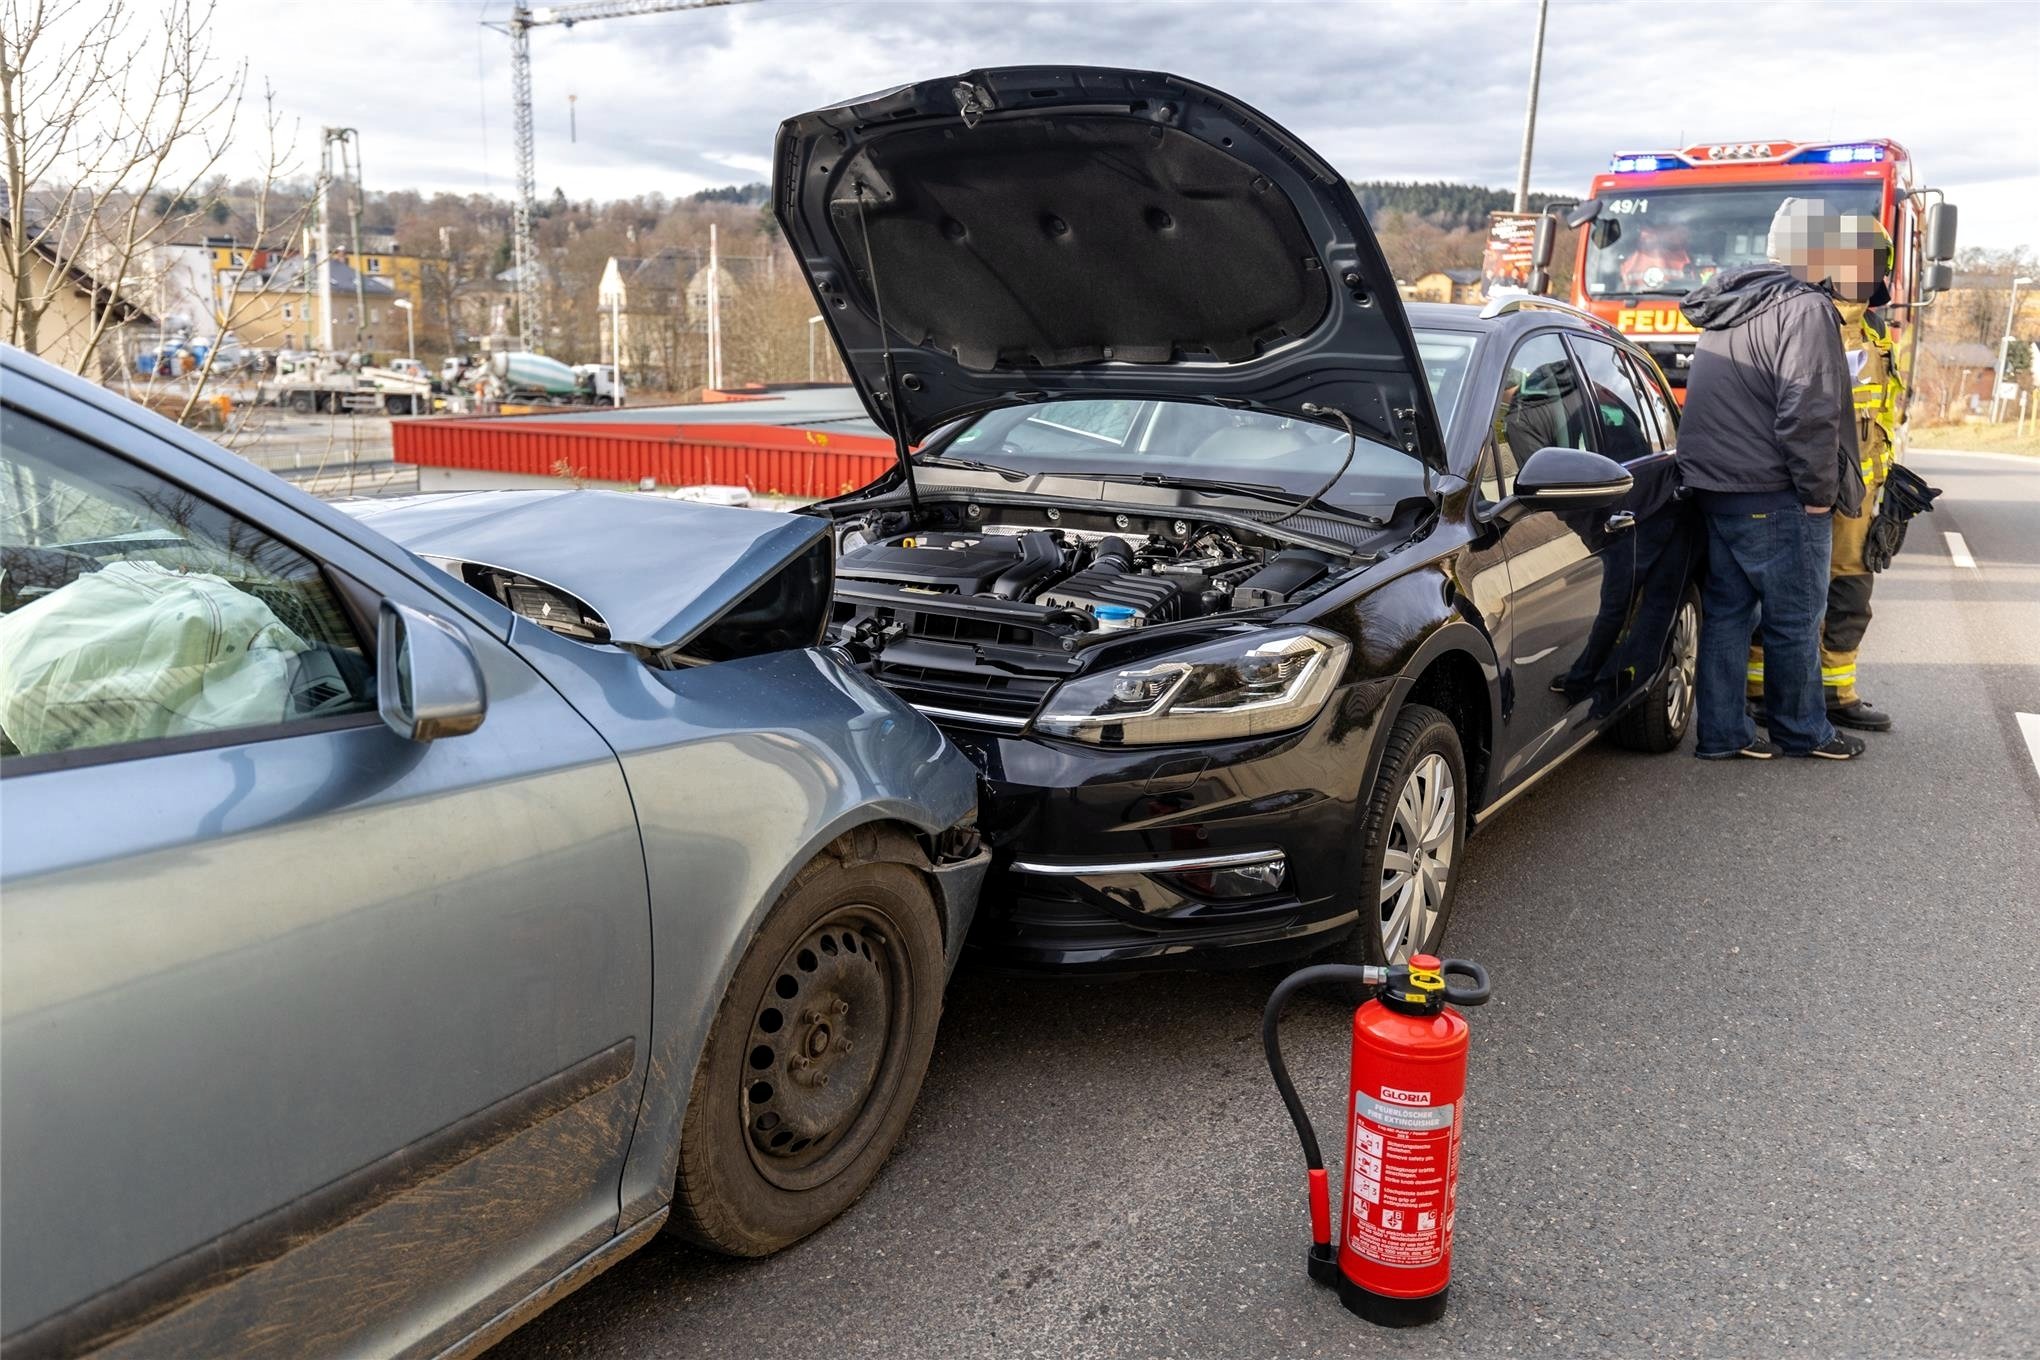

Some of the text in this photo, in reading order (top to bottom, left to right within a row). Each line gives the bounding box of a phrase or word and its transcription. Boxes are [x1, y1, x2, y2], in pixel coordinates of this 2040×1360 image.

[1608, 198, 1648, 215] 49/1
[1382, 1089, 1428, 1102] GLORIA
[1368, 1109, 1440, 1125] FIRE EXTINGUISHER
[1374, 1104, 1432, 1118] FEUERLÖSCHER
[1374, 1164, 1379, 1172] 2
[1372, 1188, 1378, 1196] 3
[1362, 1201, 1368, 1209] A
